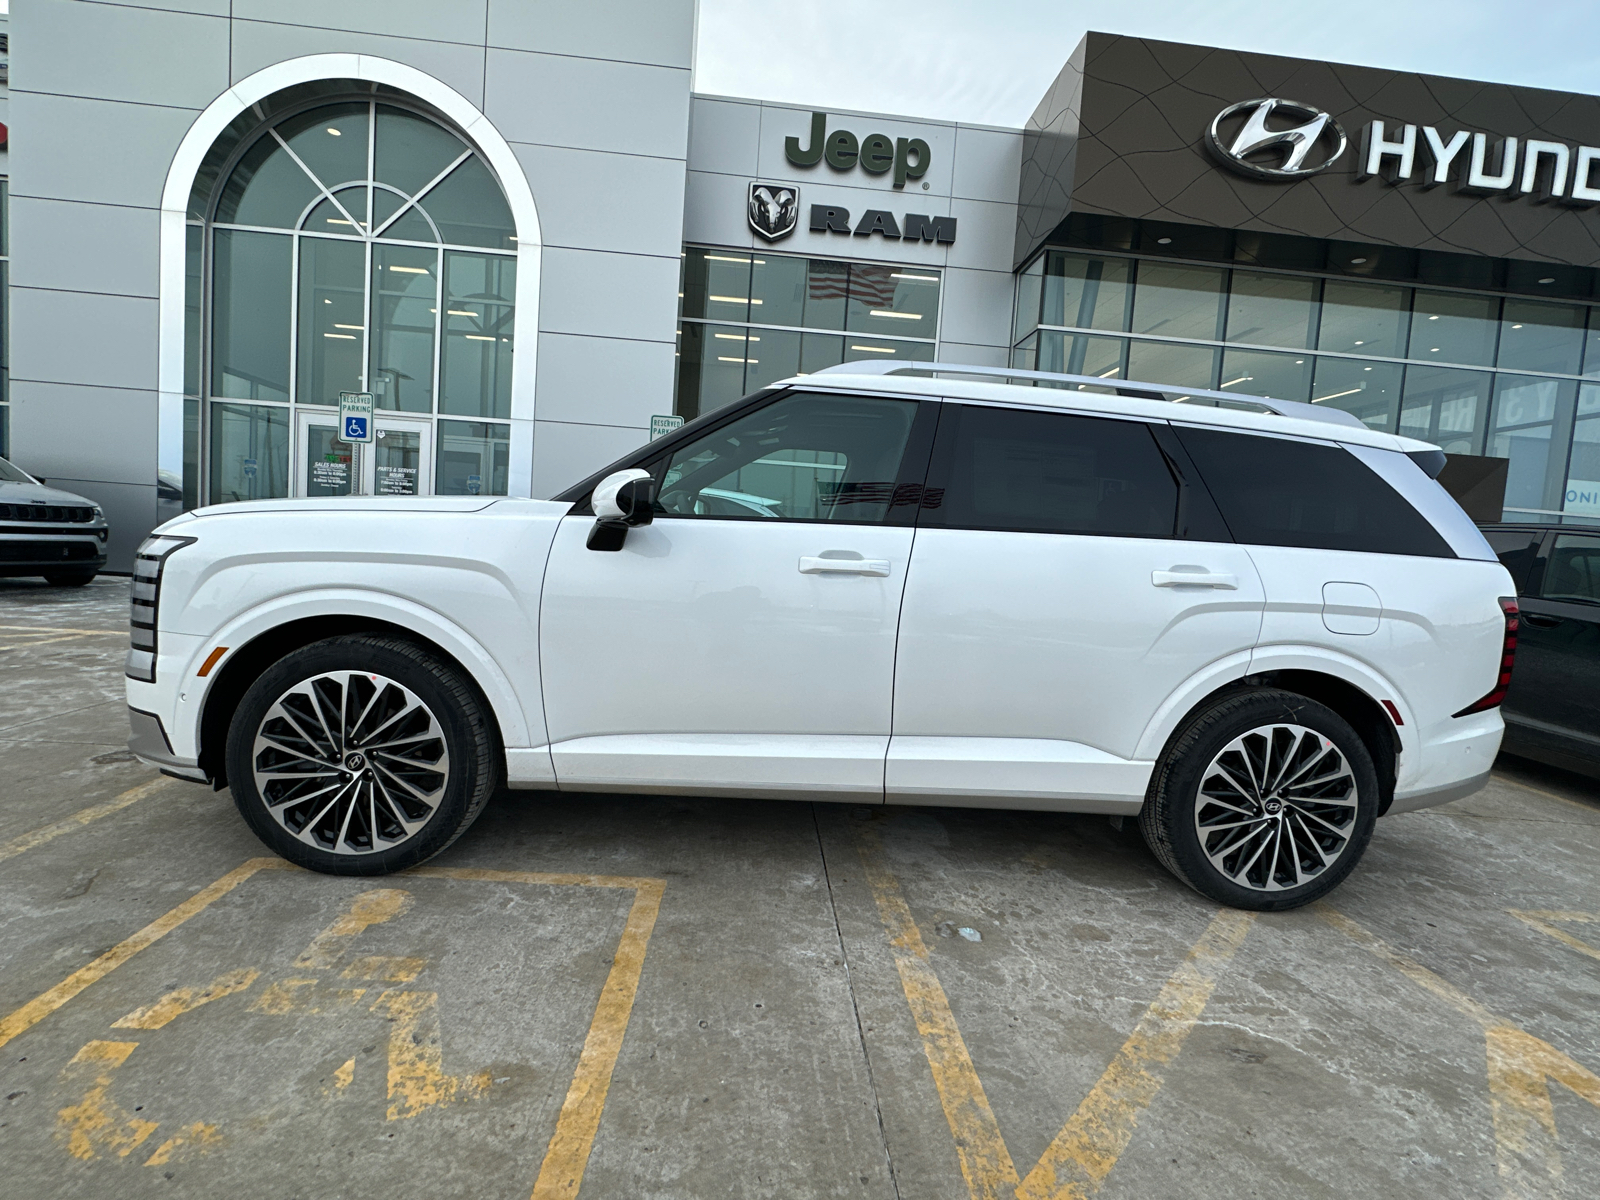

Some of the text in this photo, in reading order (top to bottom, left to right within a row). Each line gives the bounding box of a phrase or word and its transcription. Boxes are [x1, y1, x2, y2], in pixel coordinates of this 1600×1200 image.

[785, 111, 931, 189] Jeep
[809, 203, 958, 245] RAM
[343, 396, 370, 404] RESERVED
[342, 405, 371, 413] PARKING
[653, 419, 681, 427] RESERVED
